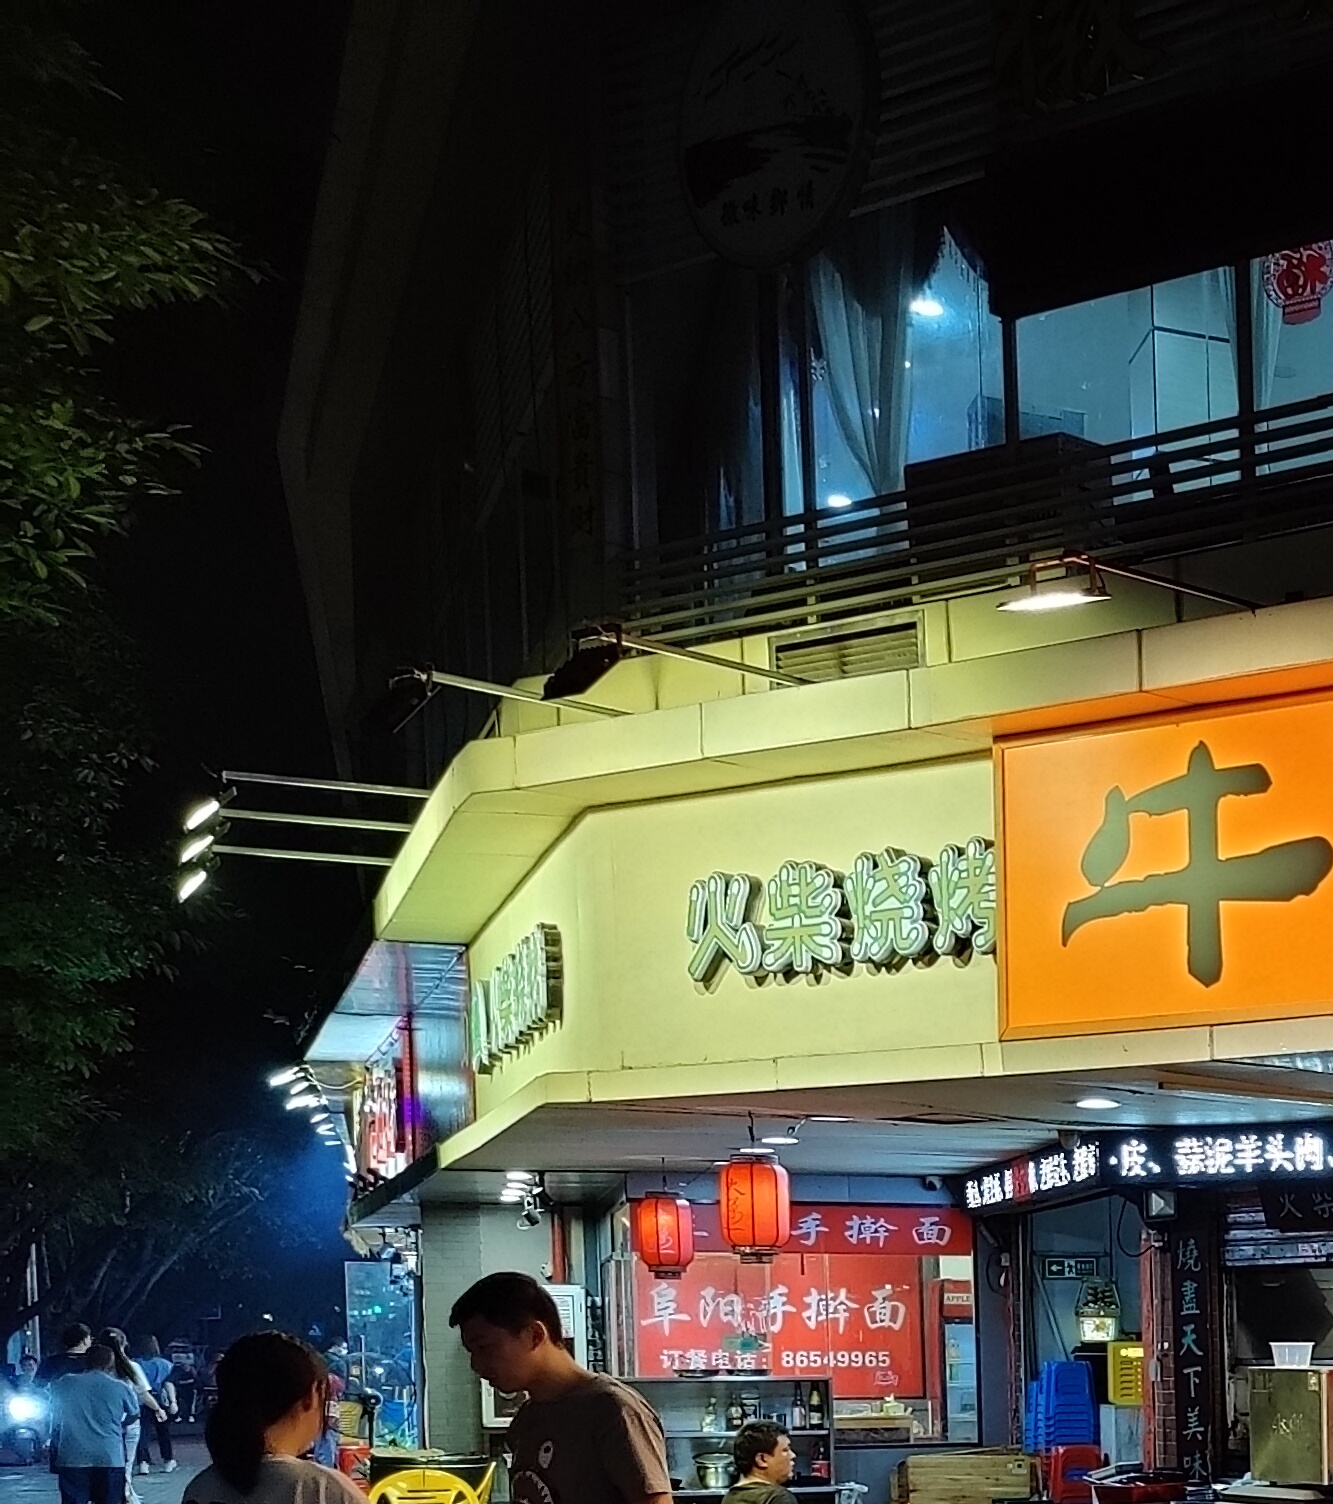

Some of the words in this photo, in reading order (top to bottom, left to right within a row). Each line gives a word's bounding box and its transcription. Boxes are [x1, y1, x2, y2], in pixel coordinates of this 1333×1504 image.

[640, 1282, 907, 1336] 阜阳手擀面
[781, 1350, 891, 1368] 86549965
